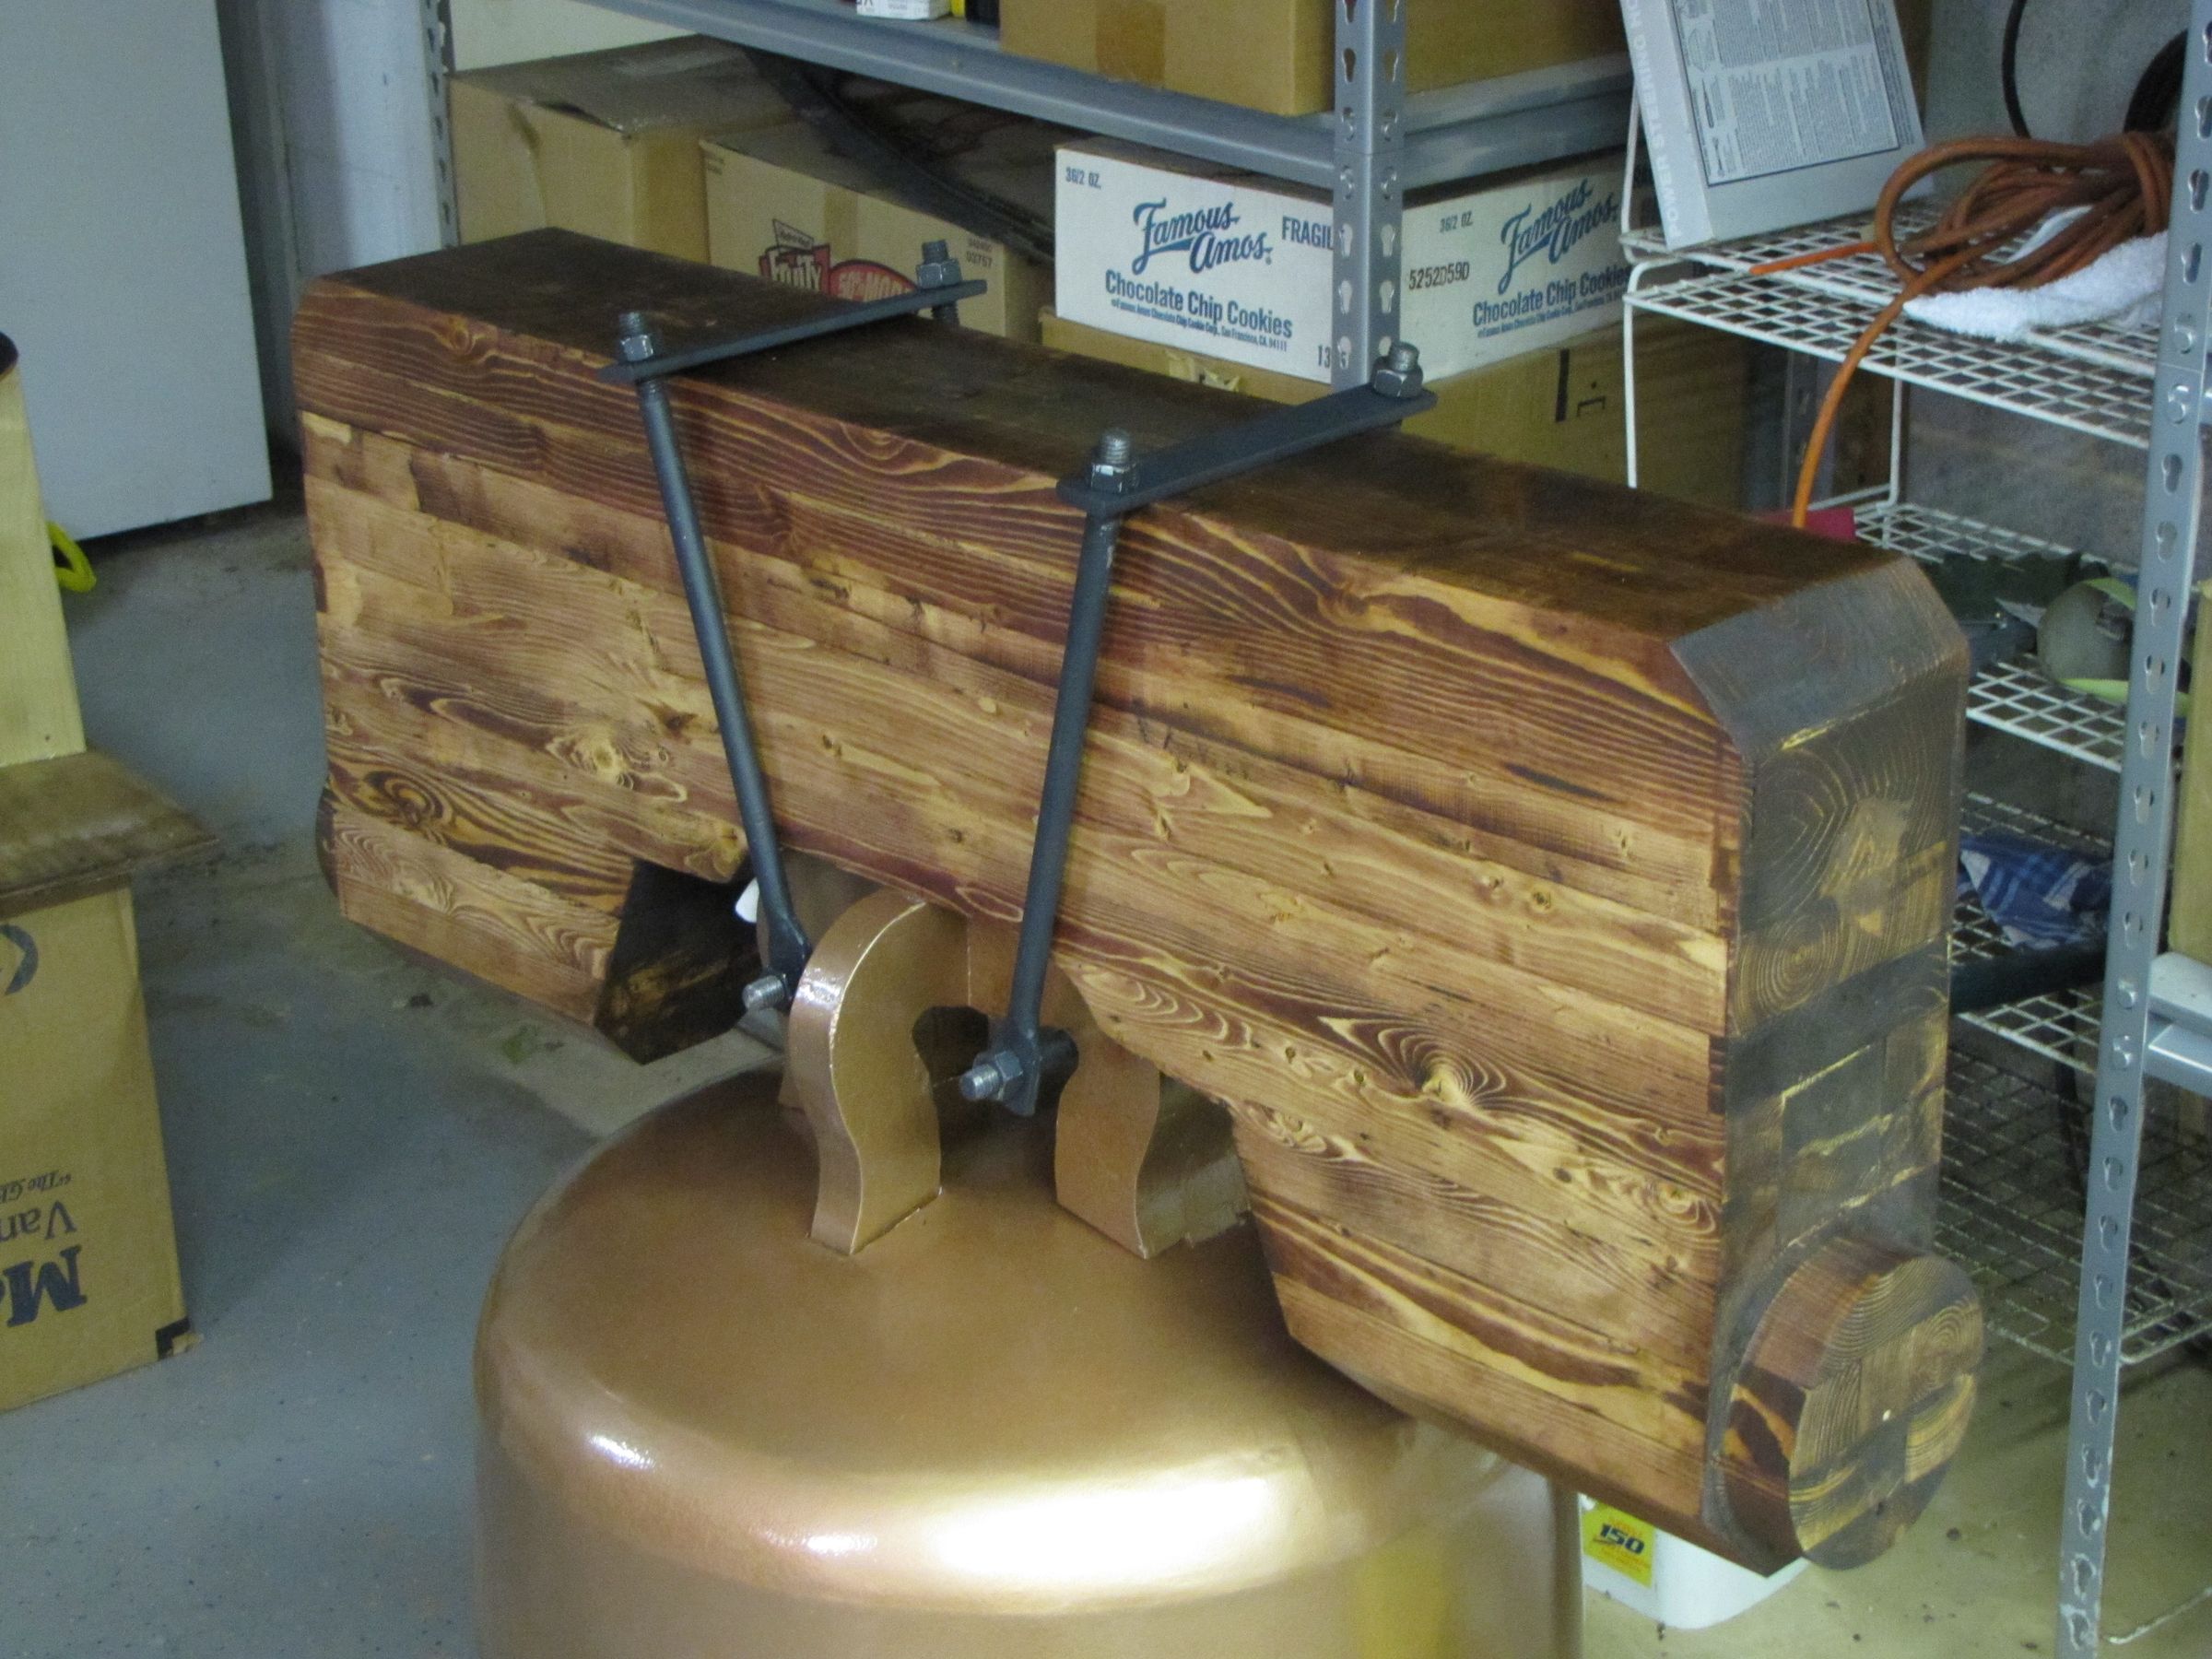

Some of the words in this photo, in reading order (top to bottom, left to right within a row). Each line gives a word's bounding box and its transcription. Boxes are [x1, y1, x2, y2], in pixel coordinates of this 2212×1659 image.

[1132, 196, 1241, 276] Famous
[1189, 230, 1274, 274] Amos
[1281, 215, 1334, 251] FRAGIL
[1497, 178, 1594, 296] Famous
[1105, 268, 1183, 312] Chocolate
[1187, 290, 1223, 324] Chip
[1227, 300, 1293, 339] Cookies
[1473, 288, 1544, 327] Chocolate
[1546, 279, 1577, 304] Chip
[1600, 1522, 1645, 1555] 150
